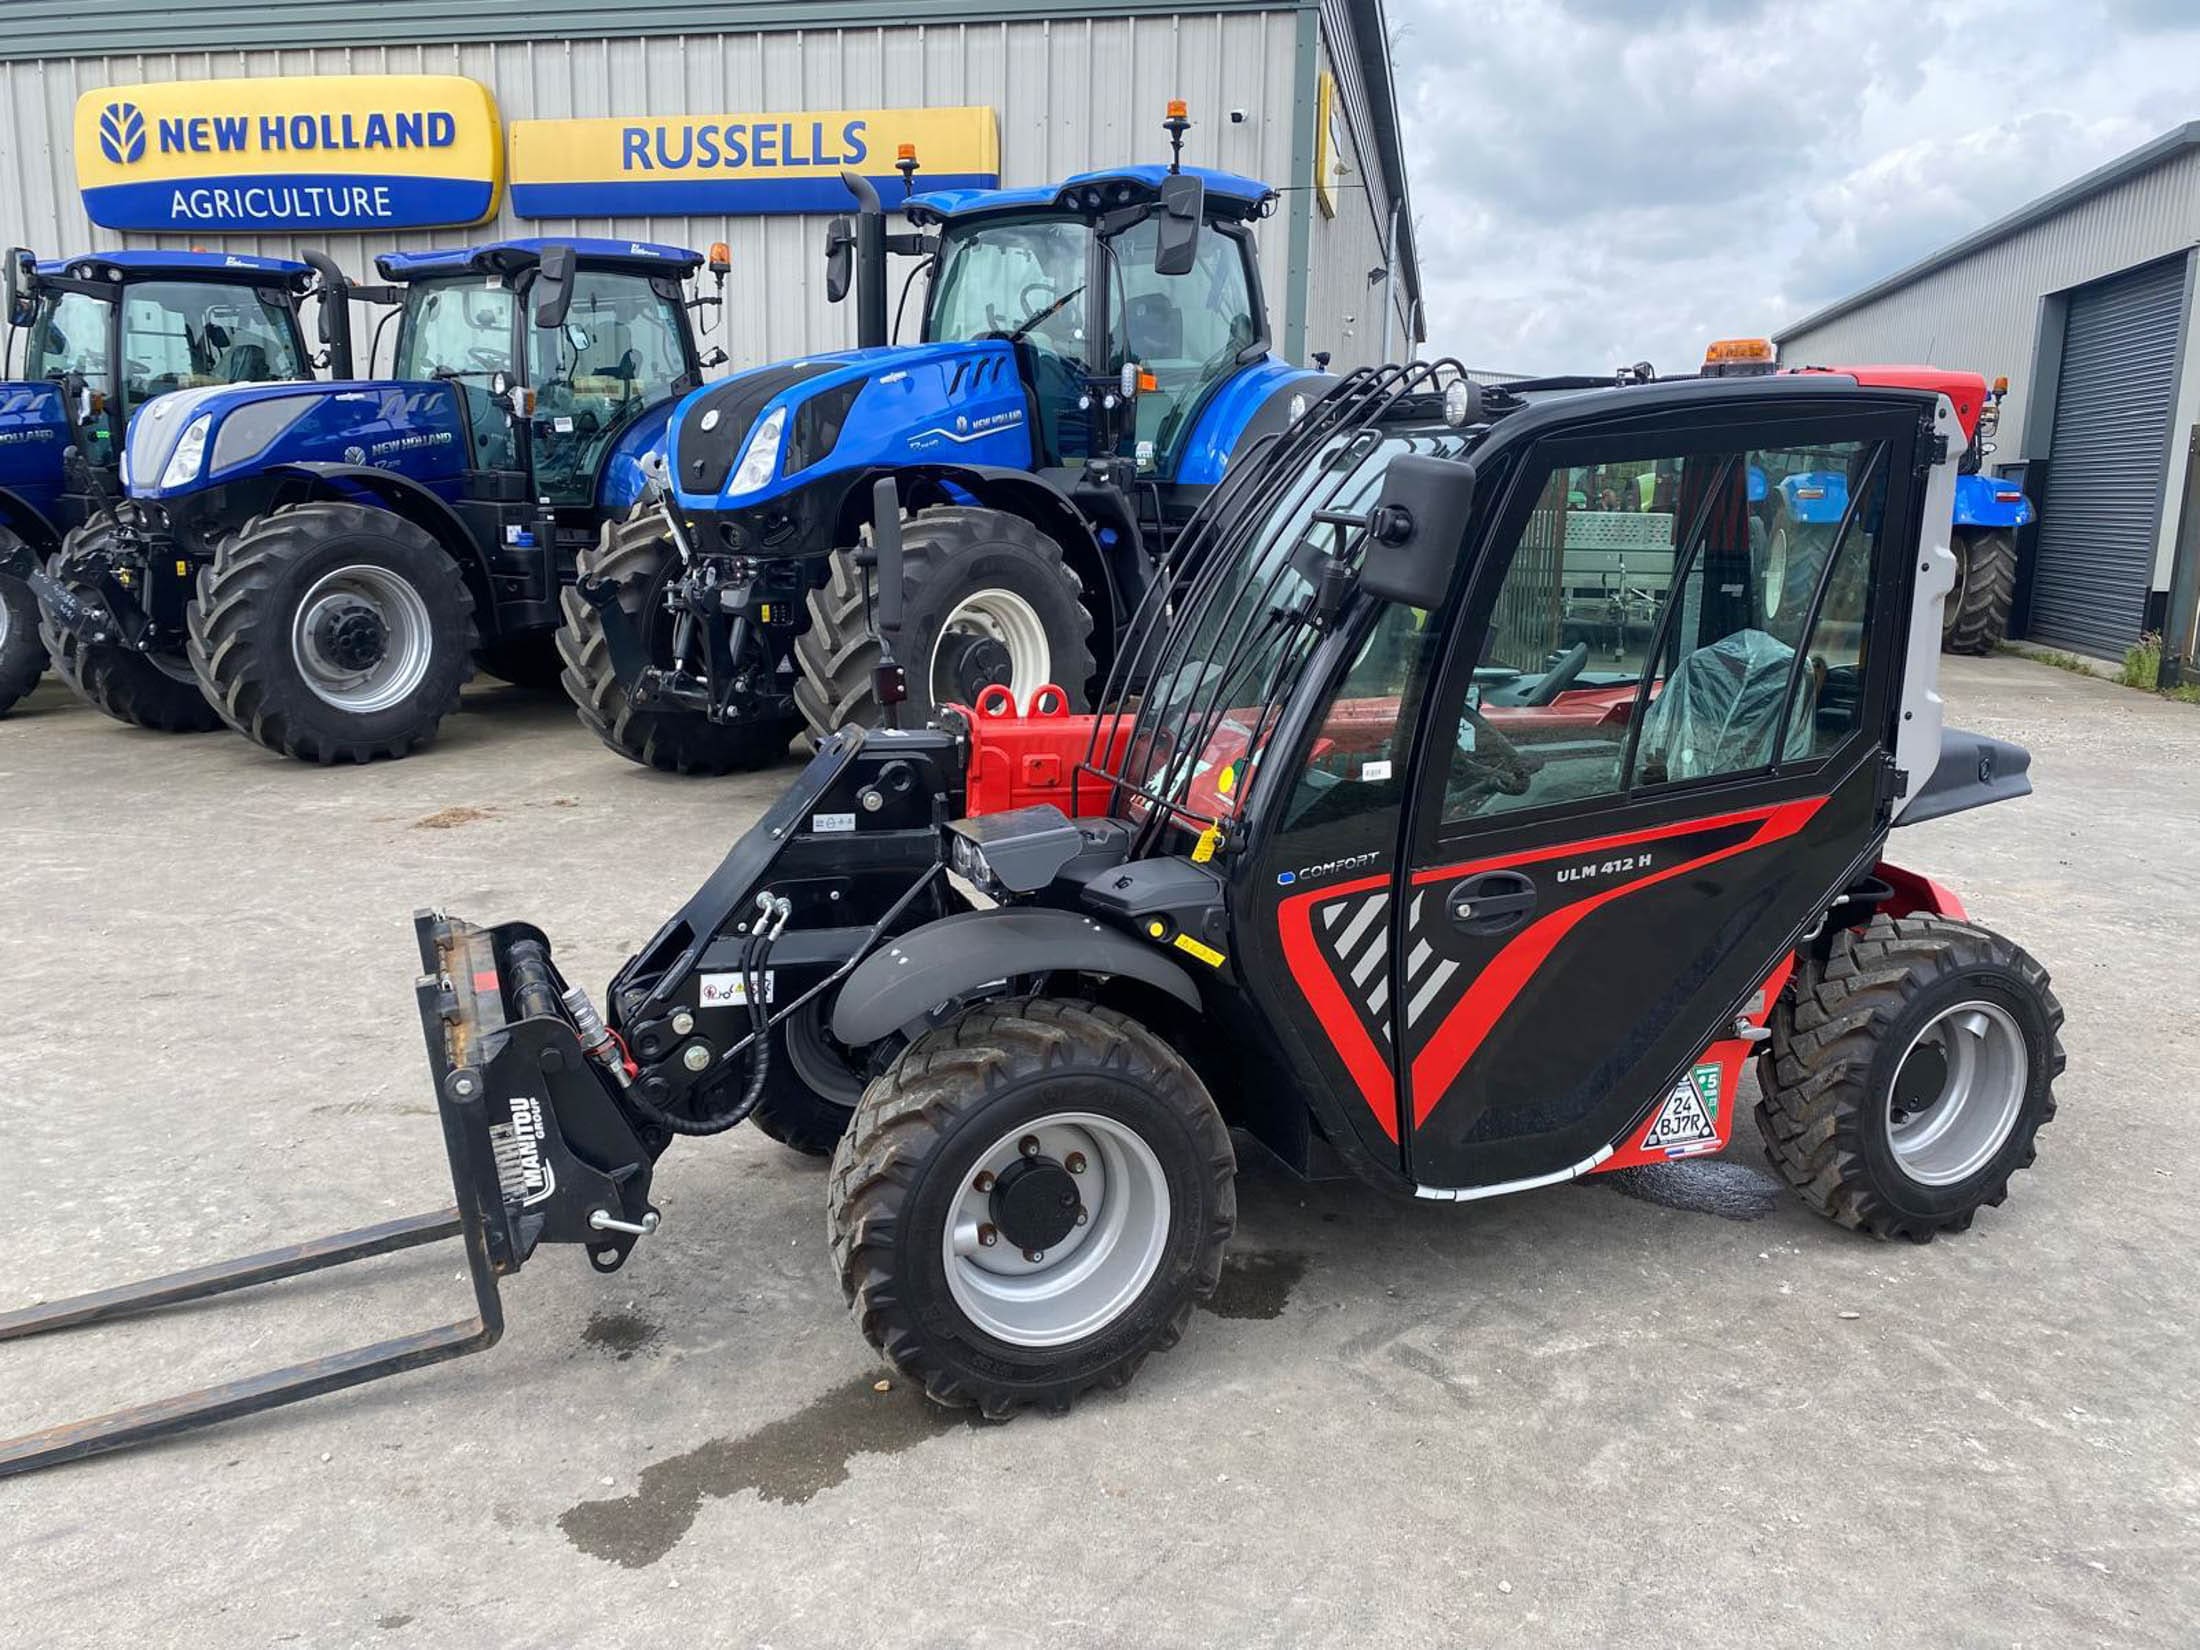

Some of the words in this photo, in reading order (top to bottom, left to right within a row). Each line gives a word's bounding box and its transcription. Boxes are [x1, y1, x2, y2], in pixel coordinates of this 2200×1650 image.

[158, 116, 249, 153] NEW
[259, 111, 456, 151] HOLLAND
[622, 120, 868, 171] RUSSELLS
[170, 186, 393, 219] AGRICULTURE
[371, 439, 400, 457] NEW
[400, 432, 452, 450] HOLLAND
[1299, 851, 1380, 880] COMFORT
[1556, 864, 1597, 882] ULM
[1600, 857, 1634, 874] 412
[1638, 853, 1652, 867] H
[529, 1096, 546, 1140] GROUP
[1673, 1095, 1692, 1115] 24
[1660, 1114, 1701, 1137] BJ7R
[509, 1097, 544, 1188] MANITOU
